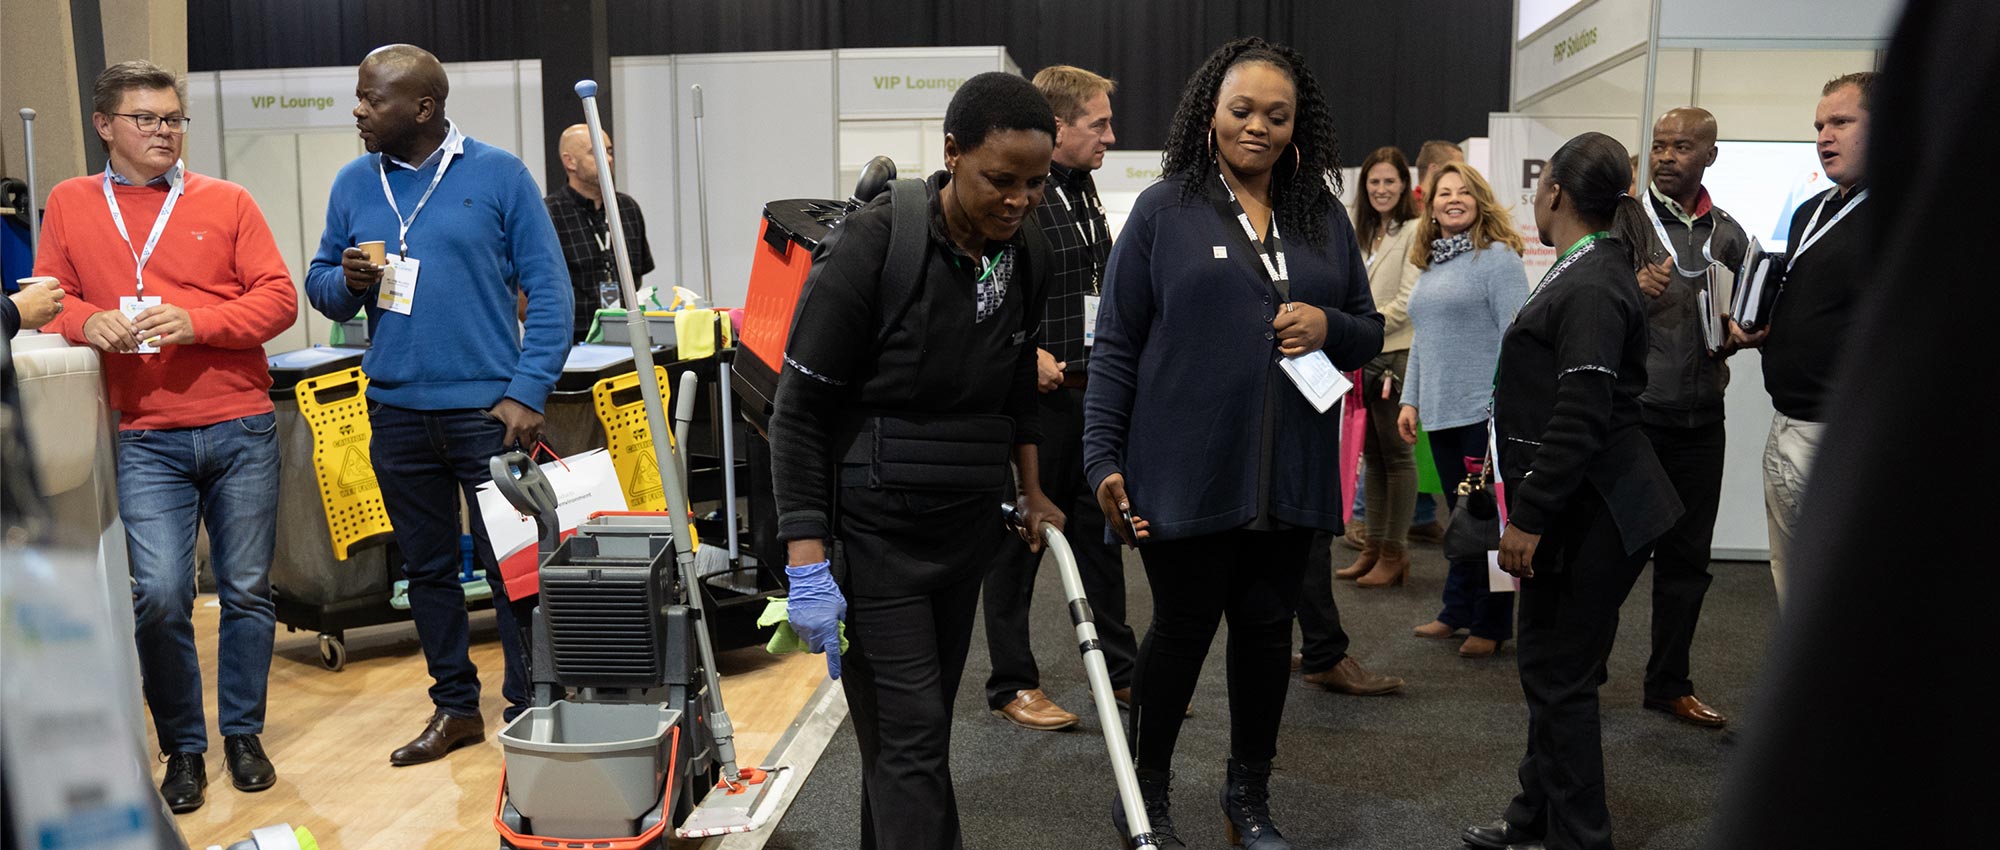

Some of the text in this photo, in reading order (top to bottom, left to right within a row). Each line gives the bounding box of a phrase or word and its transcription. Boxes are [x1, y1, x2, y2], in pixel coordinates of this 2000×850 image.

[1567, 26, 1597, 58] Solutions
[873, 76, 900, 89] VIP
[251, 96, 334, 110] VIP Lounge
